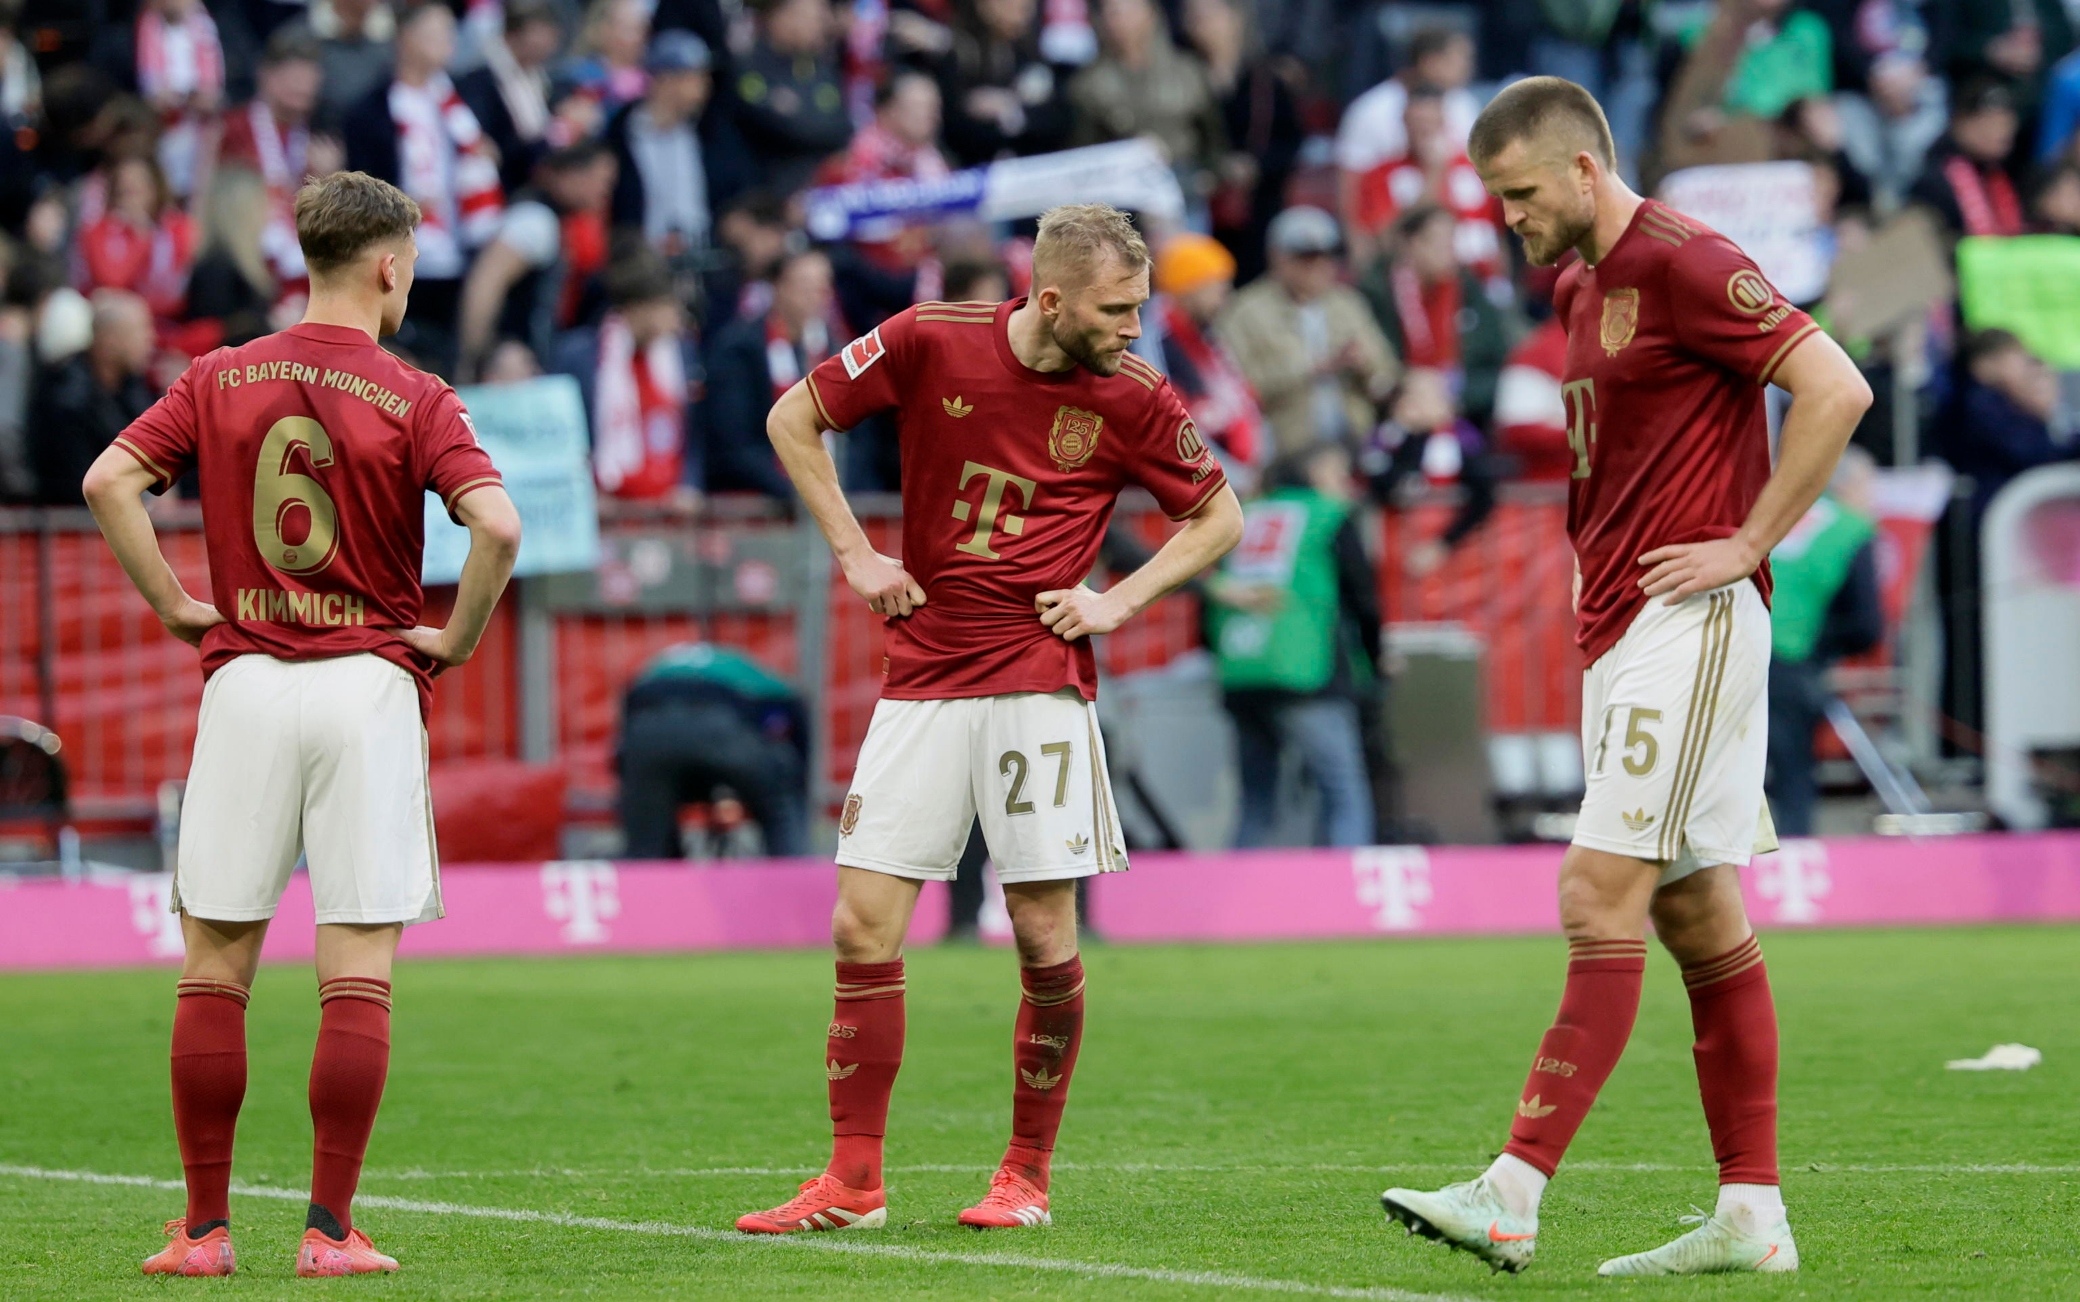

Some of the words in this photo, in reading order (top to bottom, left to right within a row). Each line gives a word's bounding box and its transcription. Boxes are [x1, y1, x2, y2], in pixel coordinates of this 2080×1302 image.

[1757, 303, 1794, 333] Allian
[218, 368, 242, 390] FC
[246, 361, 319, 385] BAYERN
[321, 368, 413, 418] MÜNCHEN
[1066, 418, 1090, 435] 125
[253, 415, 340, 576] 6
[951, 460, 1037, 560] T
[237, 588, 365, 626] KIMMICH
[999, 741, 1073, 817] 27
[540, 860, 622, 944] T
[1352, 845, 1434, 931] T
[1029, 1033, 1069, 1049] 125
[1535, 1056, 1578, 1077] 125
